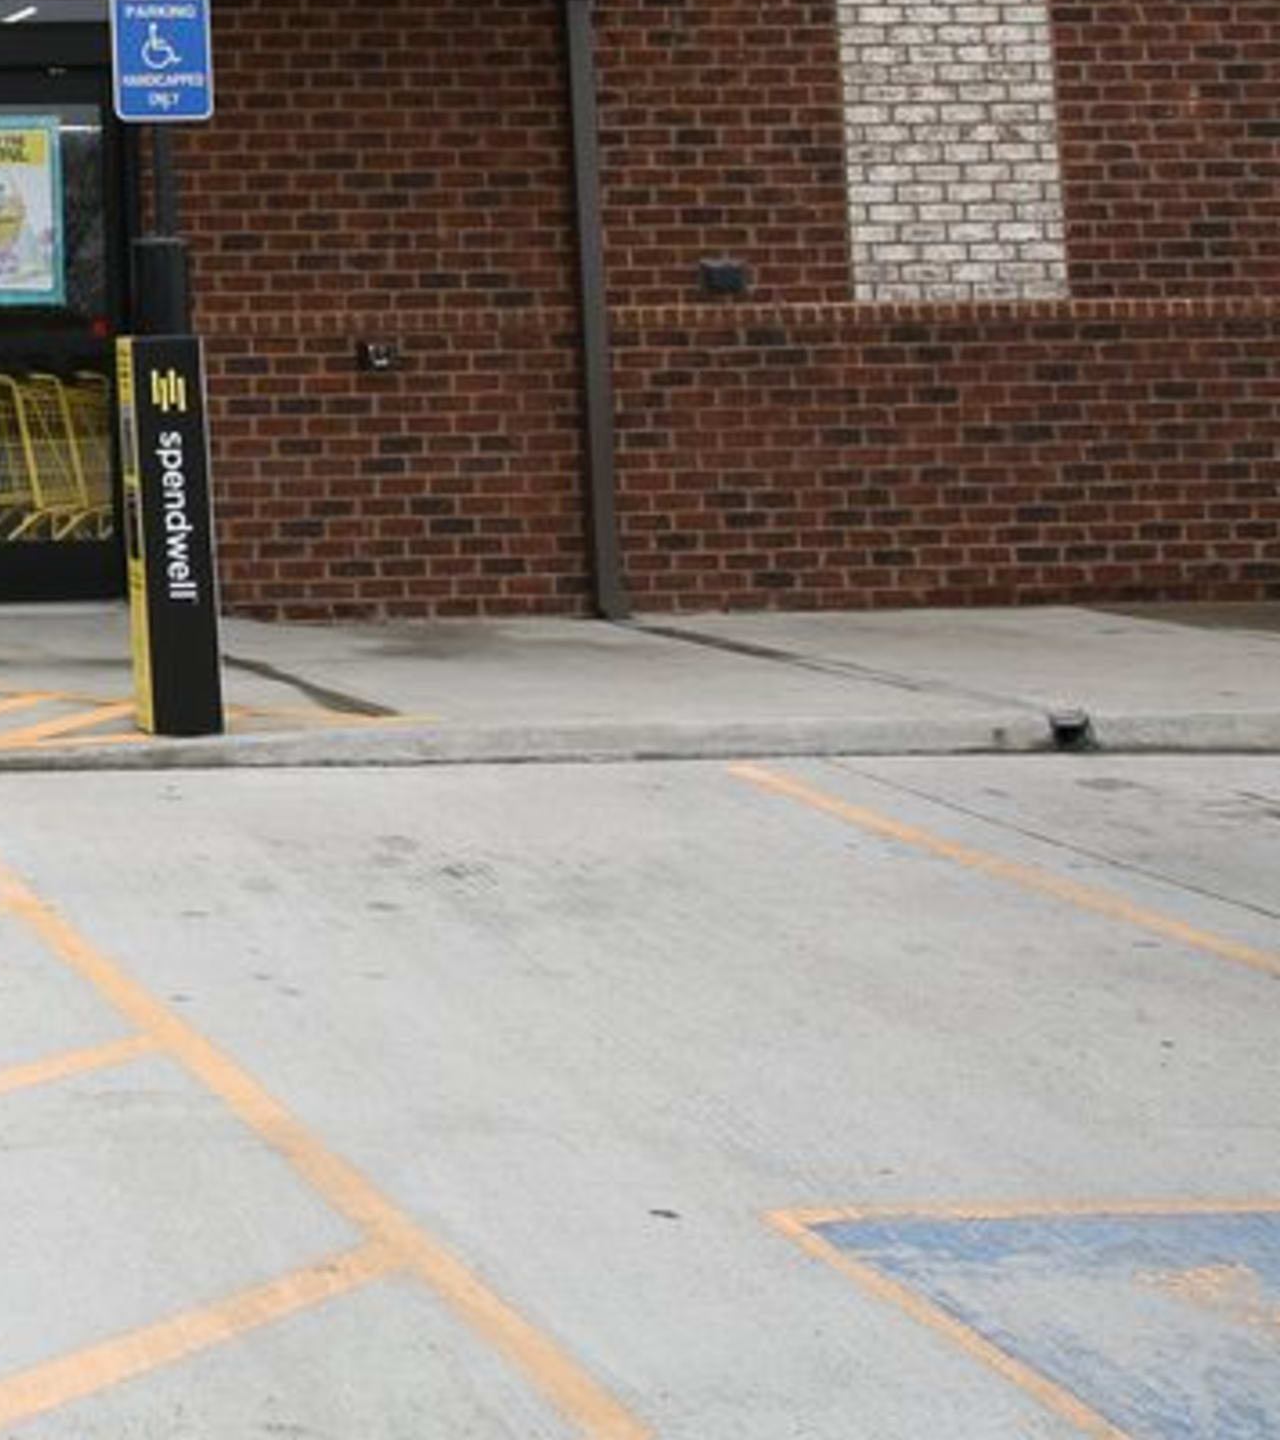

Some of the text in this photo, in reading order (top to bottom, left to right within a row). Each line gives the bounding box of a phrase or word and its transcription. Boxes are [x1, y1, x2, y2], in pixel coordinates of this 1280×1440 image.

[124, 6, 197, 19] PARKING
[123, 73, 205, 88] HANDICAPPED
[155, 430, 198, 600] spendwell
